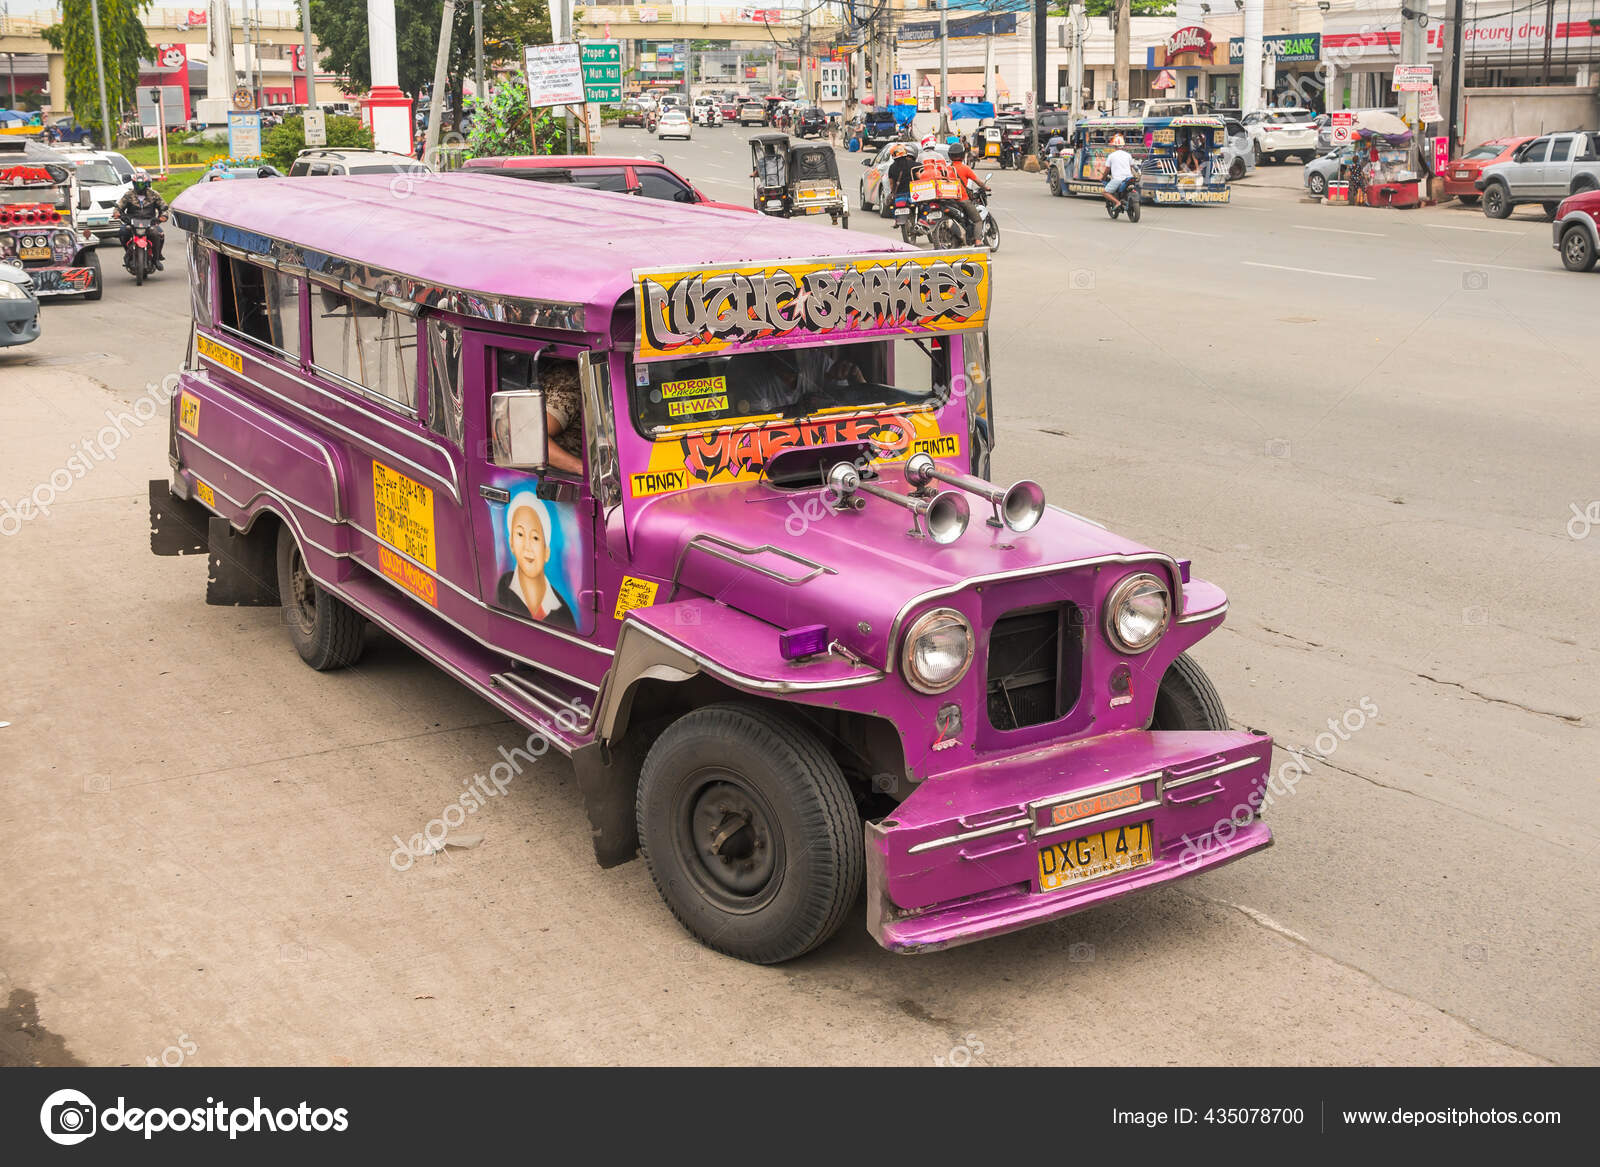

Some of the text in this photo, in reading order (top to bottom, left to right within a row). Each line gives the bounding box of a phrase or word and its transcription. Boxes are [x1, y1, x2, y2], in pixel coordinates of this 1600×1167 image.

[1464, 23, 1550, 42] ercury dru
[582, 46, 606, 60] Proper
[1230, 38, 1316, 58] ROSONSBANK
[606, 67, 619, 79] Hall
[587, 88, 608, 101] Taytay
[663, 377, 724, 396] MORONG
[670, 396, 726, 415] HI-WAY
[634, 472, 686, 495] TANAY
[1040, 823, 1144, 876] DXG 147
